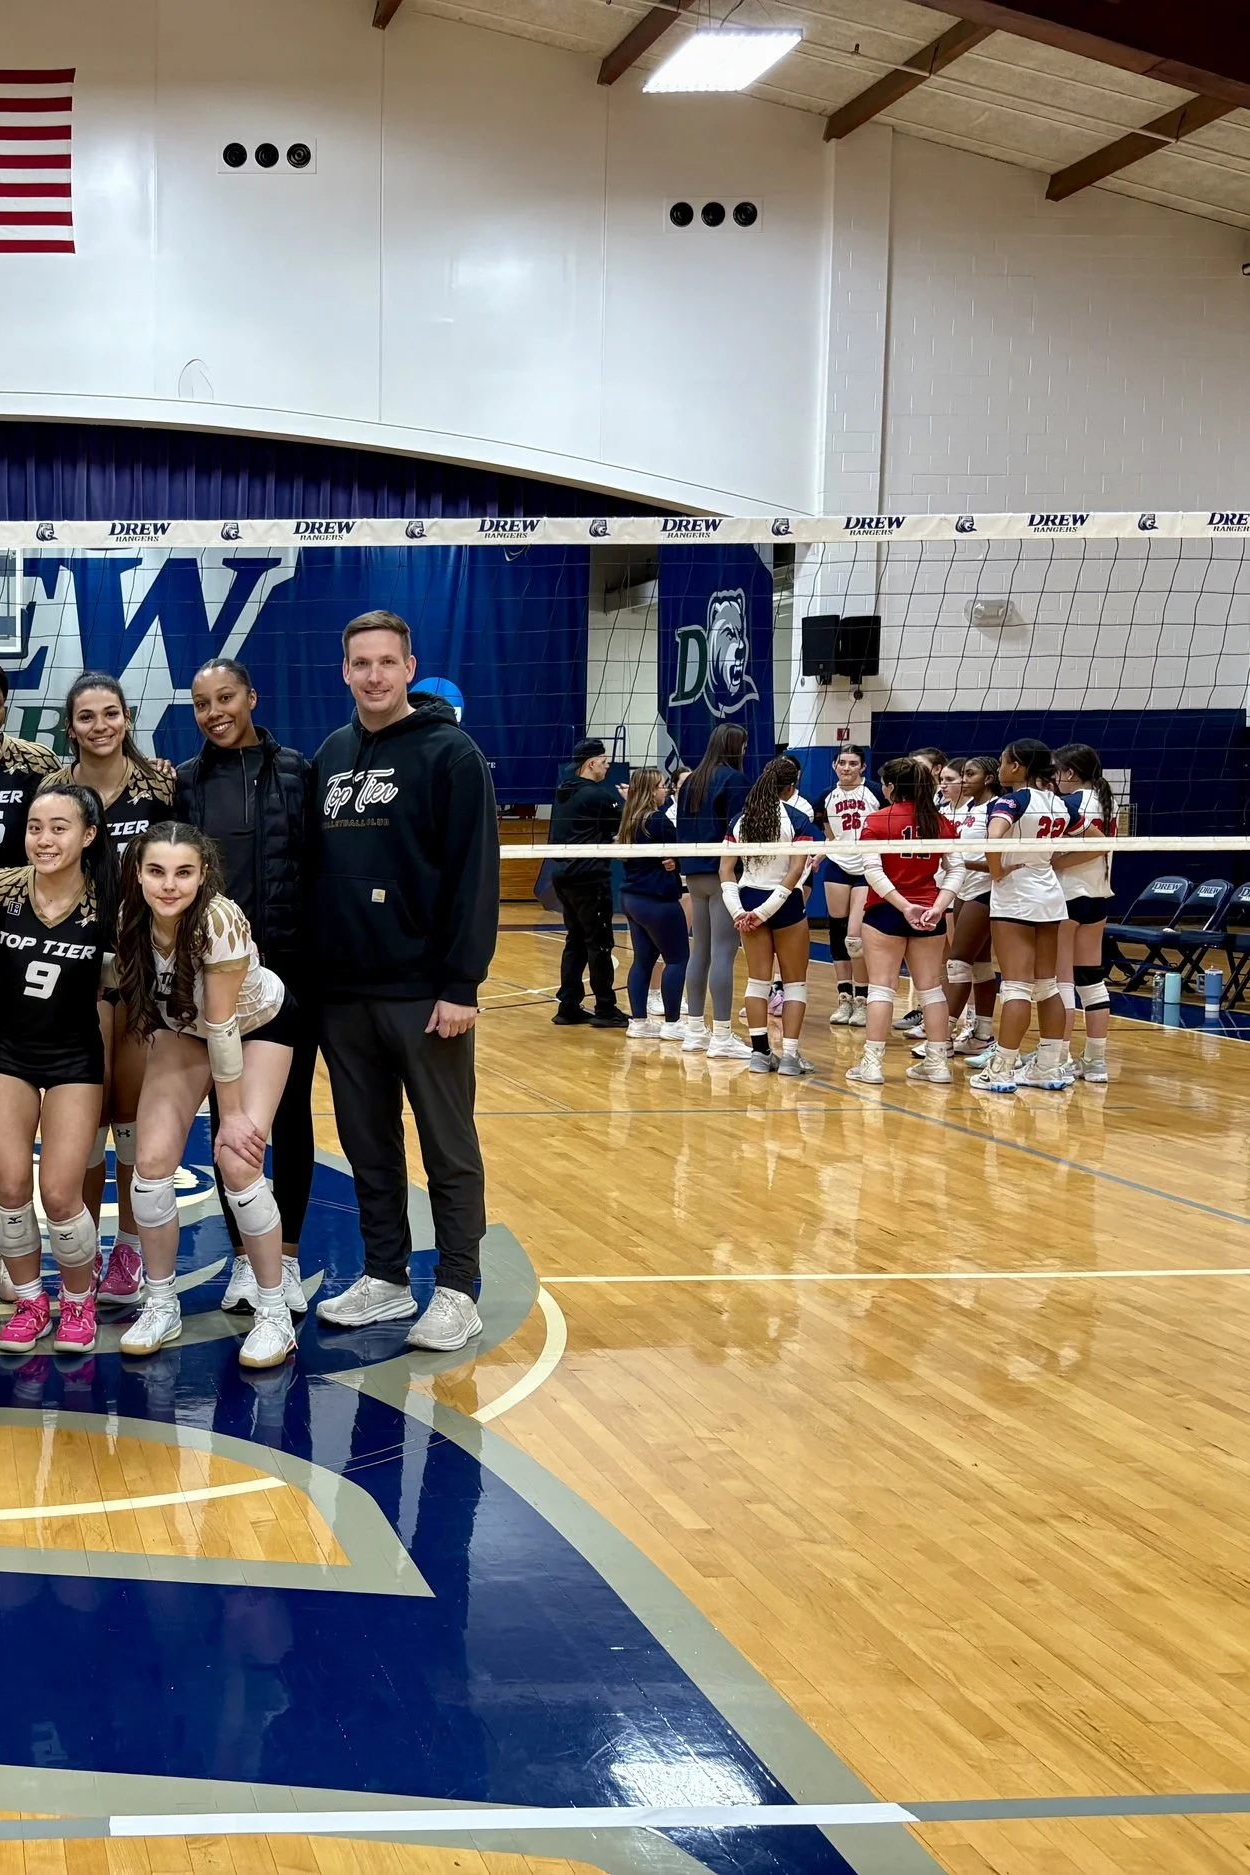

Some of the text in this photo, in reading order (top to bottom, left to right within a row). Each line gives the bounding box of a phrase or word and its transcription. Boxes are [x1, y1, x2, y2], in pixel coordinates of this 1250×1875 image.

[478, 518, 540, 532] DREW
[660, 518, 722, 531] DREW
[844, 516, 905, 529] DREW
[1027, 513, 1089, 526] DREW
[1207, 511, 1250, 525] DRE
[109, 522, 170, 535] DREW
[293, 521, 355, 534] DREW
[324, 768, 399, 819] Top Tier
[106, 820, 149, 836] IER
[842, 812, 861, 831] 26
[1037, 816, 1066, 838] 22
[1152, 881, 1183, 890] DREW
[0, 931, 97, 960] TOP TIER
[23, 961, 61, 999] 9
